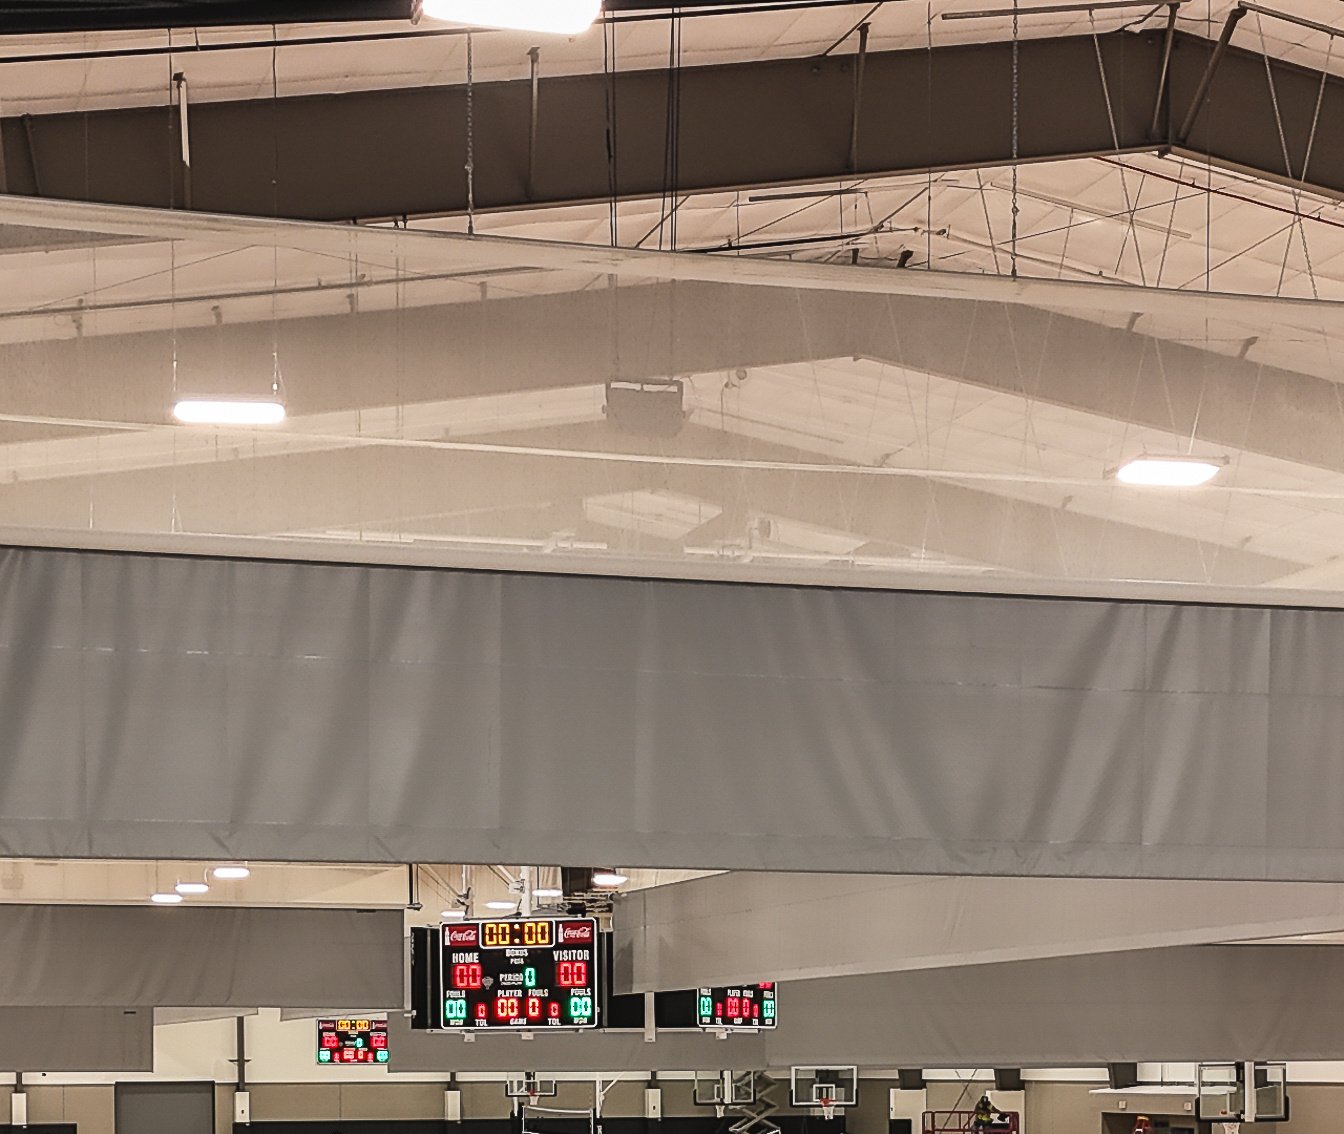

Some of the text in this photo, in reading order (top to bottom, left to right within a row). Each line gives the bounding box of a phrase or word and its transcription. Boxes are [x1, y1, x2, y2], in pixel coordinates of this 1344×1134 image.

[485, 922, 550, 945] 00:00
[452, 952, 479, 963] HOME
[553, 950, 590, 961] VISITOR
[456, 965, 481, 986] 00
[525, 967, 536, 986] 0
[560, 963, 586, 985] 00
[497, 989, 522, 998] PLAYER
[528, 988, 548, 997] FOULS
[446, 999, 466, 1018] 00
[497, 998, 519, 1017] 00
[528, 998, 539, 1017] 0
[570, 997, 592, 1017] 00
